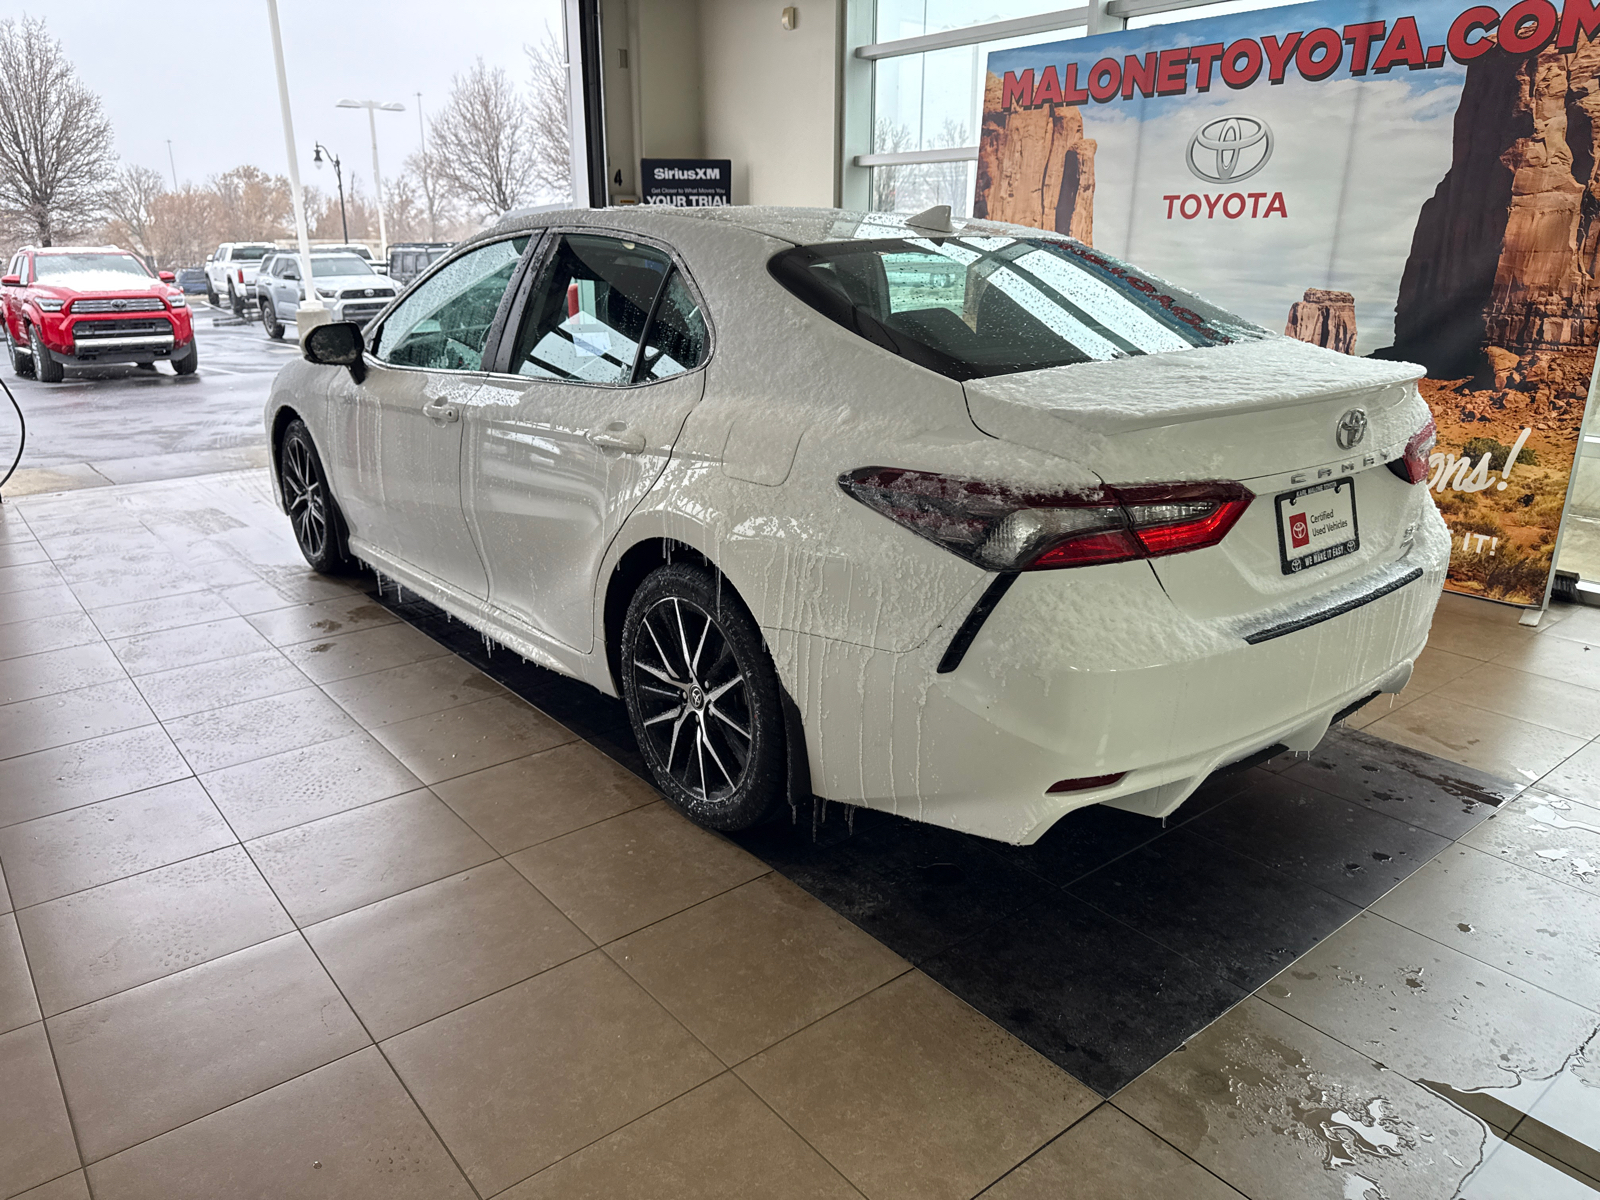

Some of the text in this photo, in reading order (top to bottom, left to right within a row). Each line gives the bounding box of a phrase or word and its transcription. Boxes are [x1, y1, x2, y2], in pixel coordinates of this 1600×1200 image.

[614, 168, 622, 186] 4
[653, 167, 720, 180] SiriusXM
[646, 195, 686, 207] YOUR
[1163, 191, 1288, 219] TOYOTA
[1310, 508, 1334, 524] Certified
[1312, 519, 1348, 537] Used Vehicles
[1462, 532, 1498, 556] IT!
[1304, 556, 1313, 566] WE
[1313, 551, 1327, 563] MAKE
[1332, 545, 1344, 557] EASY
